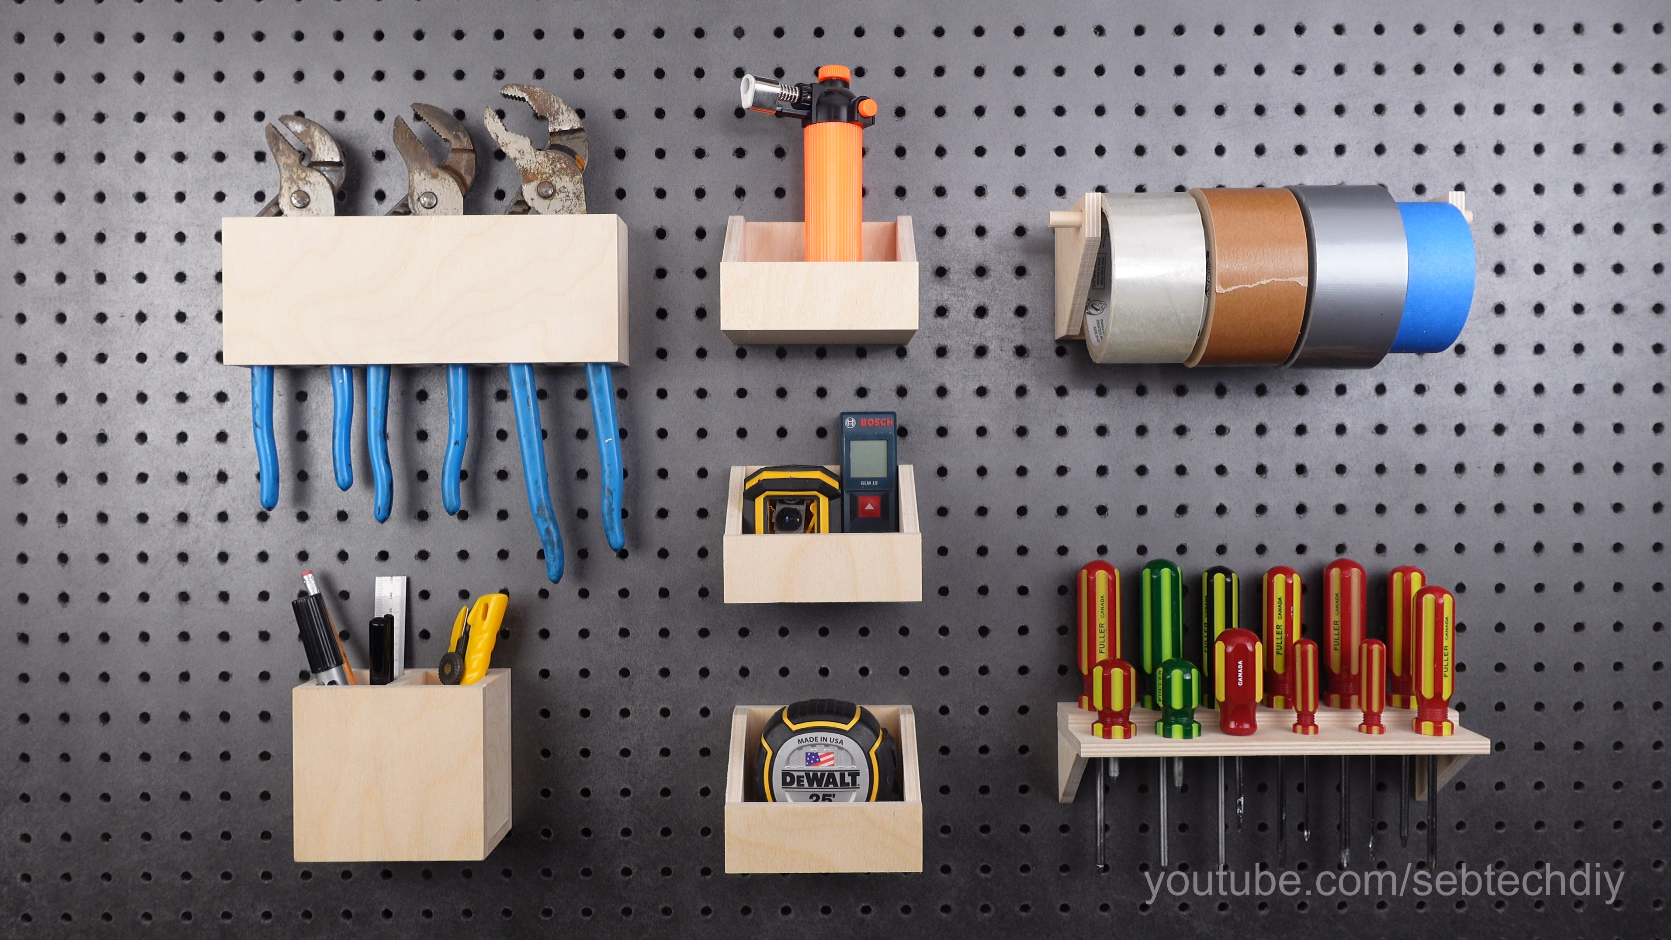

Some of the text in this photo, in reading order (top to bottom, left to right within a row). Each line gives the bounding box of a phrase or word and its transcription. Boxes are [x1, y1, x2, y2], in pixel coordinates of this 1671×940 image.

[860, 418, 894, 427] BOSCH
[1098, 622, 1106, 654] FULLER
[1275, 624, 1283, 656] FULLER
[797, 736, 819, 744] MADE
[830, 737, 844, 745] USA
